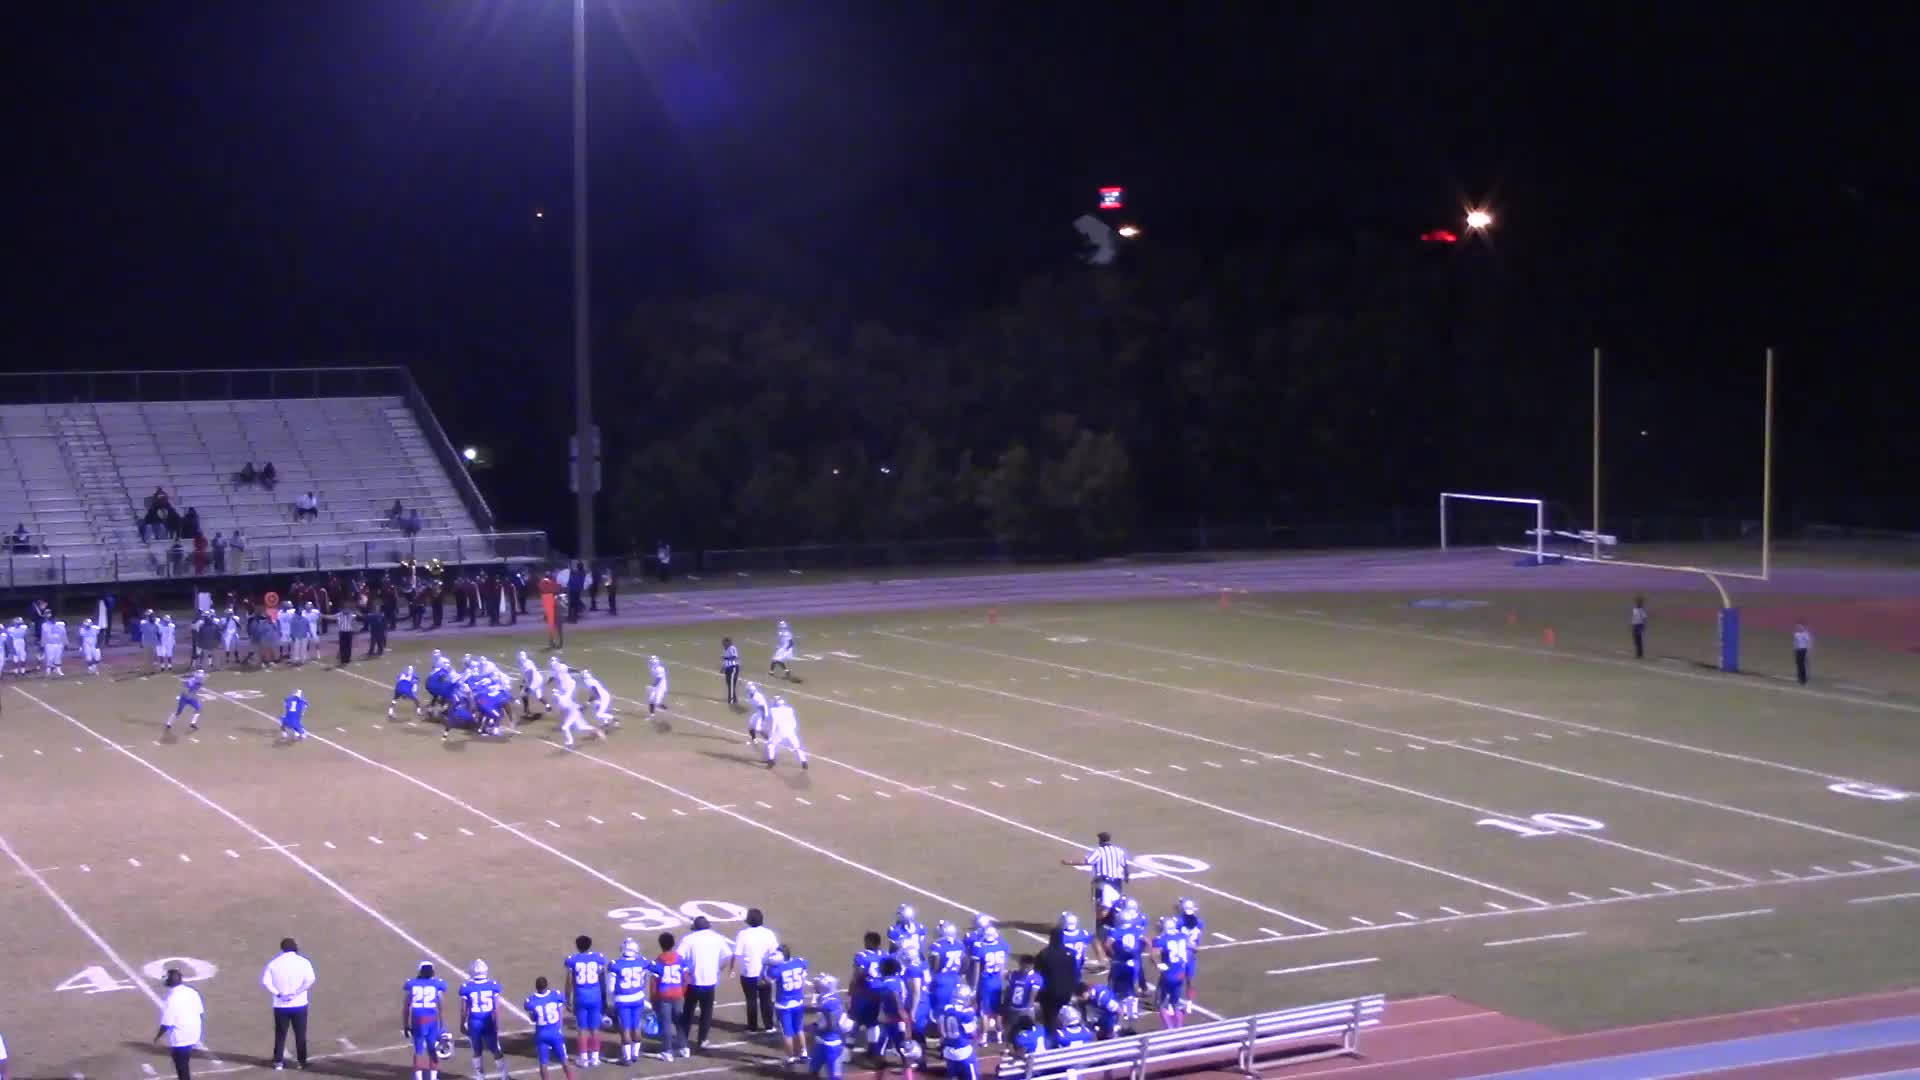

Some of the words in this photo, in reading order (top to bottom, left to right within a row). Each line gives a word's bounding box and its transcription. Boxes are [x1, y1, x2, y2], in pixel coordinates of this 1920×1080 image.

[1474, 813, 1605, 837] 10
[1073, 854, 1211, 880] 0
[607, 900, 749, 931] 30
[54, 957, 219, 994] 40
[575, 961, 599, 985] 38
[620, 966, 643, 989] 35
[660, 964, 681, 984] 45
[781, 967, 803, 992] 55
[411, 985, 437, 1008] 22
[470, 990, 494, 1013] 15
